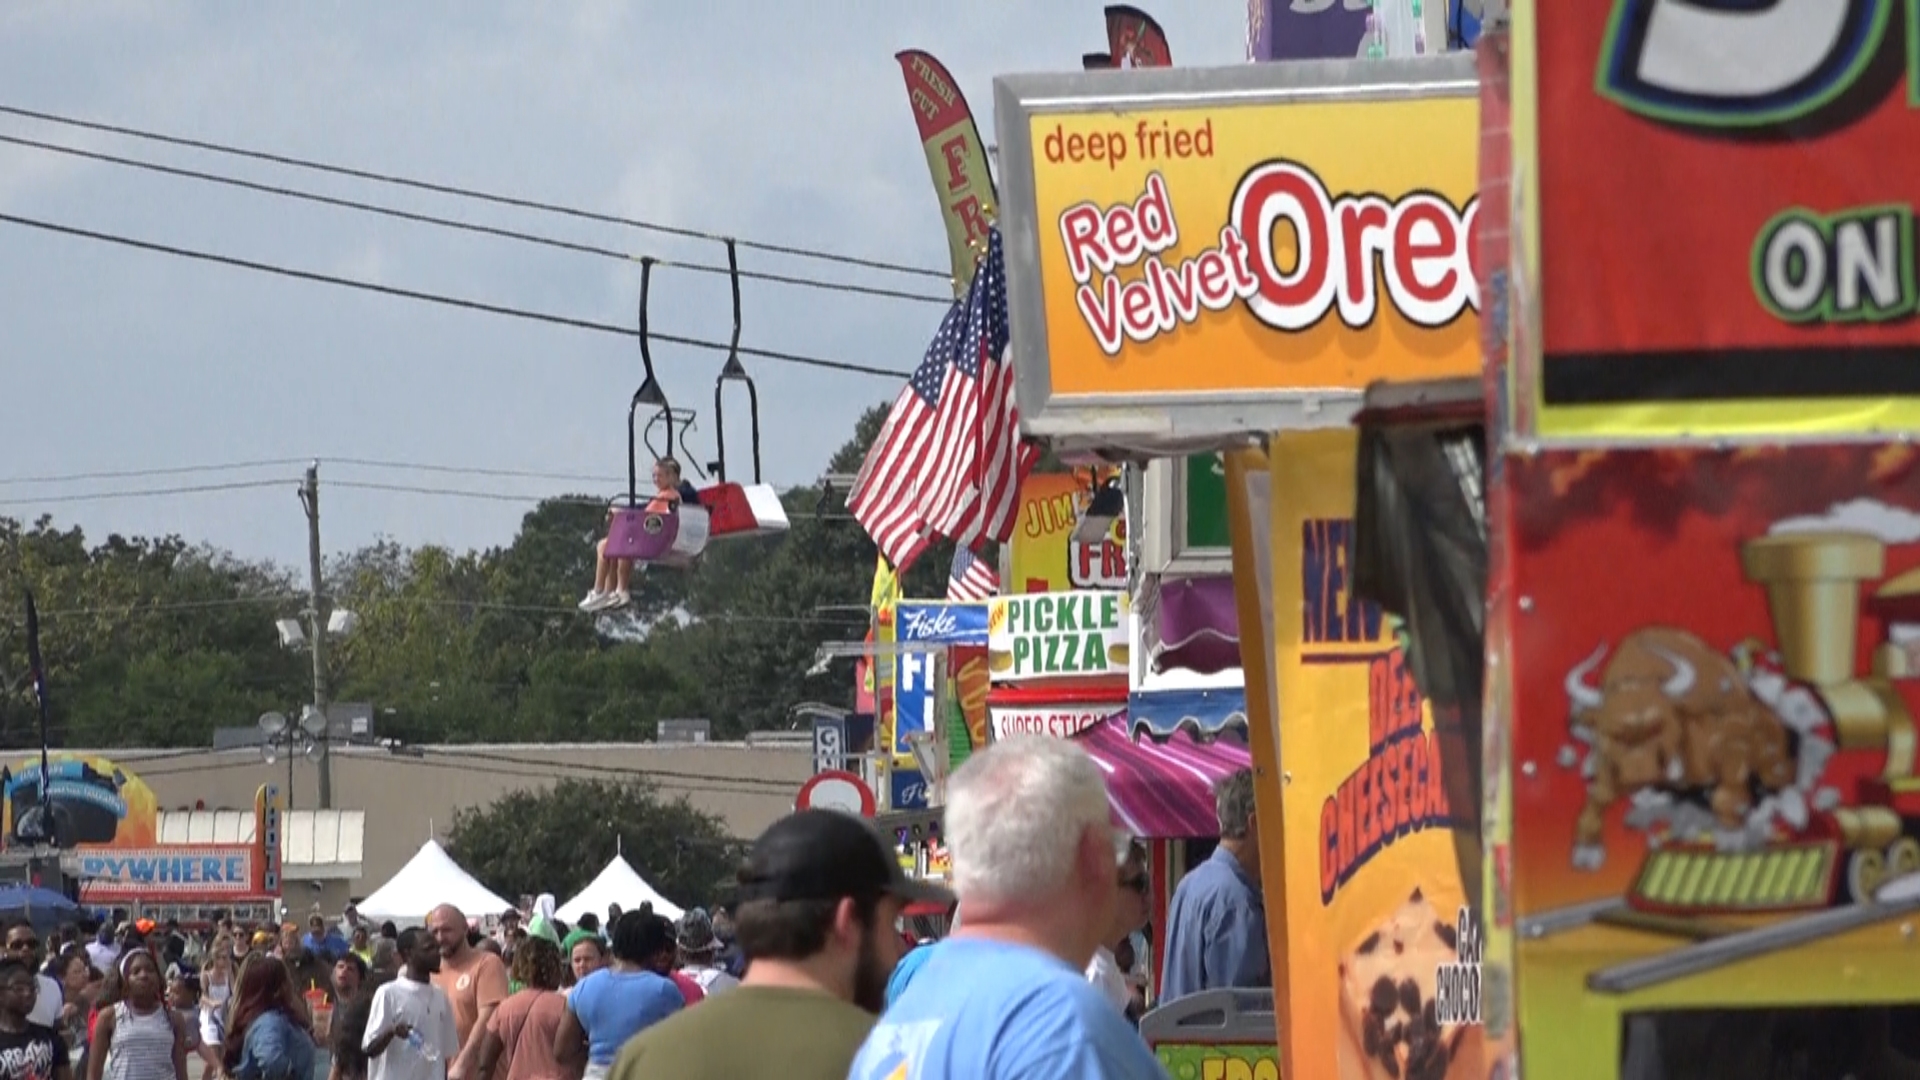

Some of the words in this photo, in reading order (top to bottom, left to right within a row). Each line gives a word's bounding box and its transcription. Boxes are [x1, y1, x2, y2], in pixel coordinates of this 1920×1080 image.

[911, 56, 956, 106] FRESH
[912, 88, 940, 121] CUT
[1044, 123, 1128, 170] deep
[1135, 118, 1214, 159] fried
[941, 134, 989, 249] FR
[1062, 173, 1176, 281] Red
[1233, 163, 1479, 328] Ore
[1079, 228, 1257, 351] Velvet
[1756, 209, 1909, 318] ON
[1078, 540, 1127, 580] FR
[903, 607, 957, 639] Fiske
[1007, 595, 1119, 634] PICKLE
[1013, 632, 1108, 675] PIZZA
[1320, 729, 1452, 905] CHEESECA
[1437, 964, 1481, 1023] CHOCO
